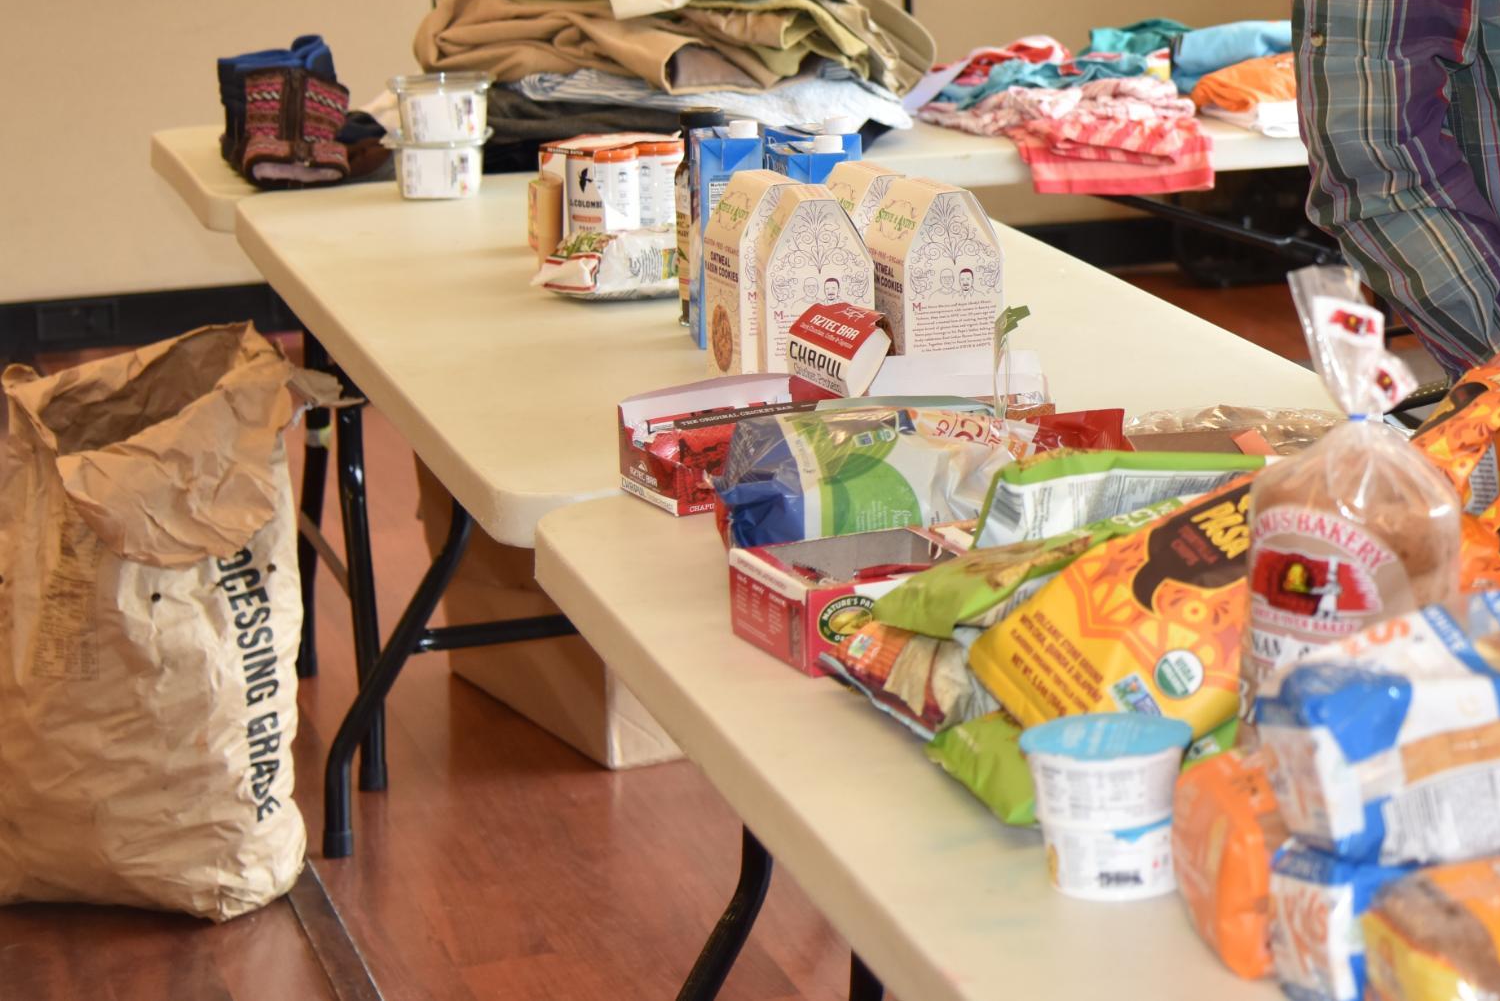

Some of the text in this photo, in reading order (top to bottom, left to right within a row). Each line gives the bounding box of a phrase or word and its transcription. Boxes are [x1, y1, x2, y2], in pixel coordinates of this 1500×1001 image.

[710, 250, 731, 268] OATMEAL
[718, 265, 739, 283] COOKIES
[880, 278, 903, 294] COOKIES
[810, 314, 860, 340] AZTEC BAR
[789, 340, 843, 381] CHAPUL
[699, 412, 739, 423] ORIGINAL
[739, 406, 776, 417] CRICKET
[1297, 512, 1387, 569] BAKERY
[822, 596, 858, 621] NATURE'S
[246, 710, 282, 823] GRADE
